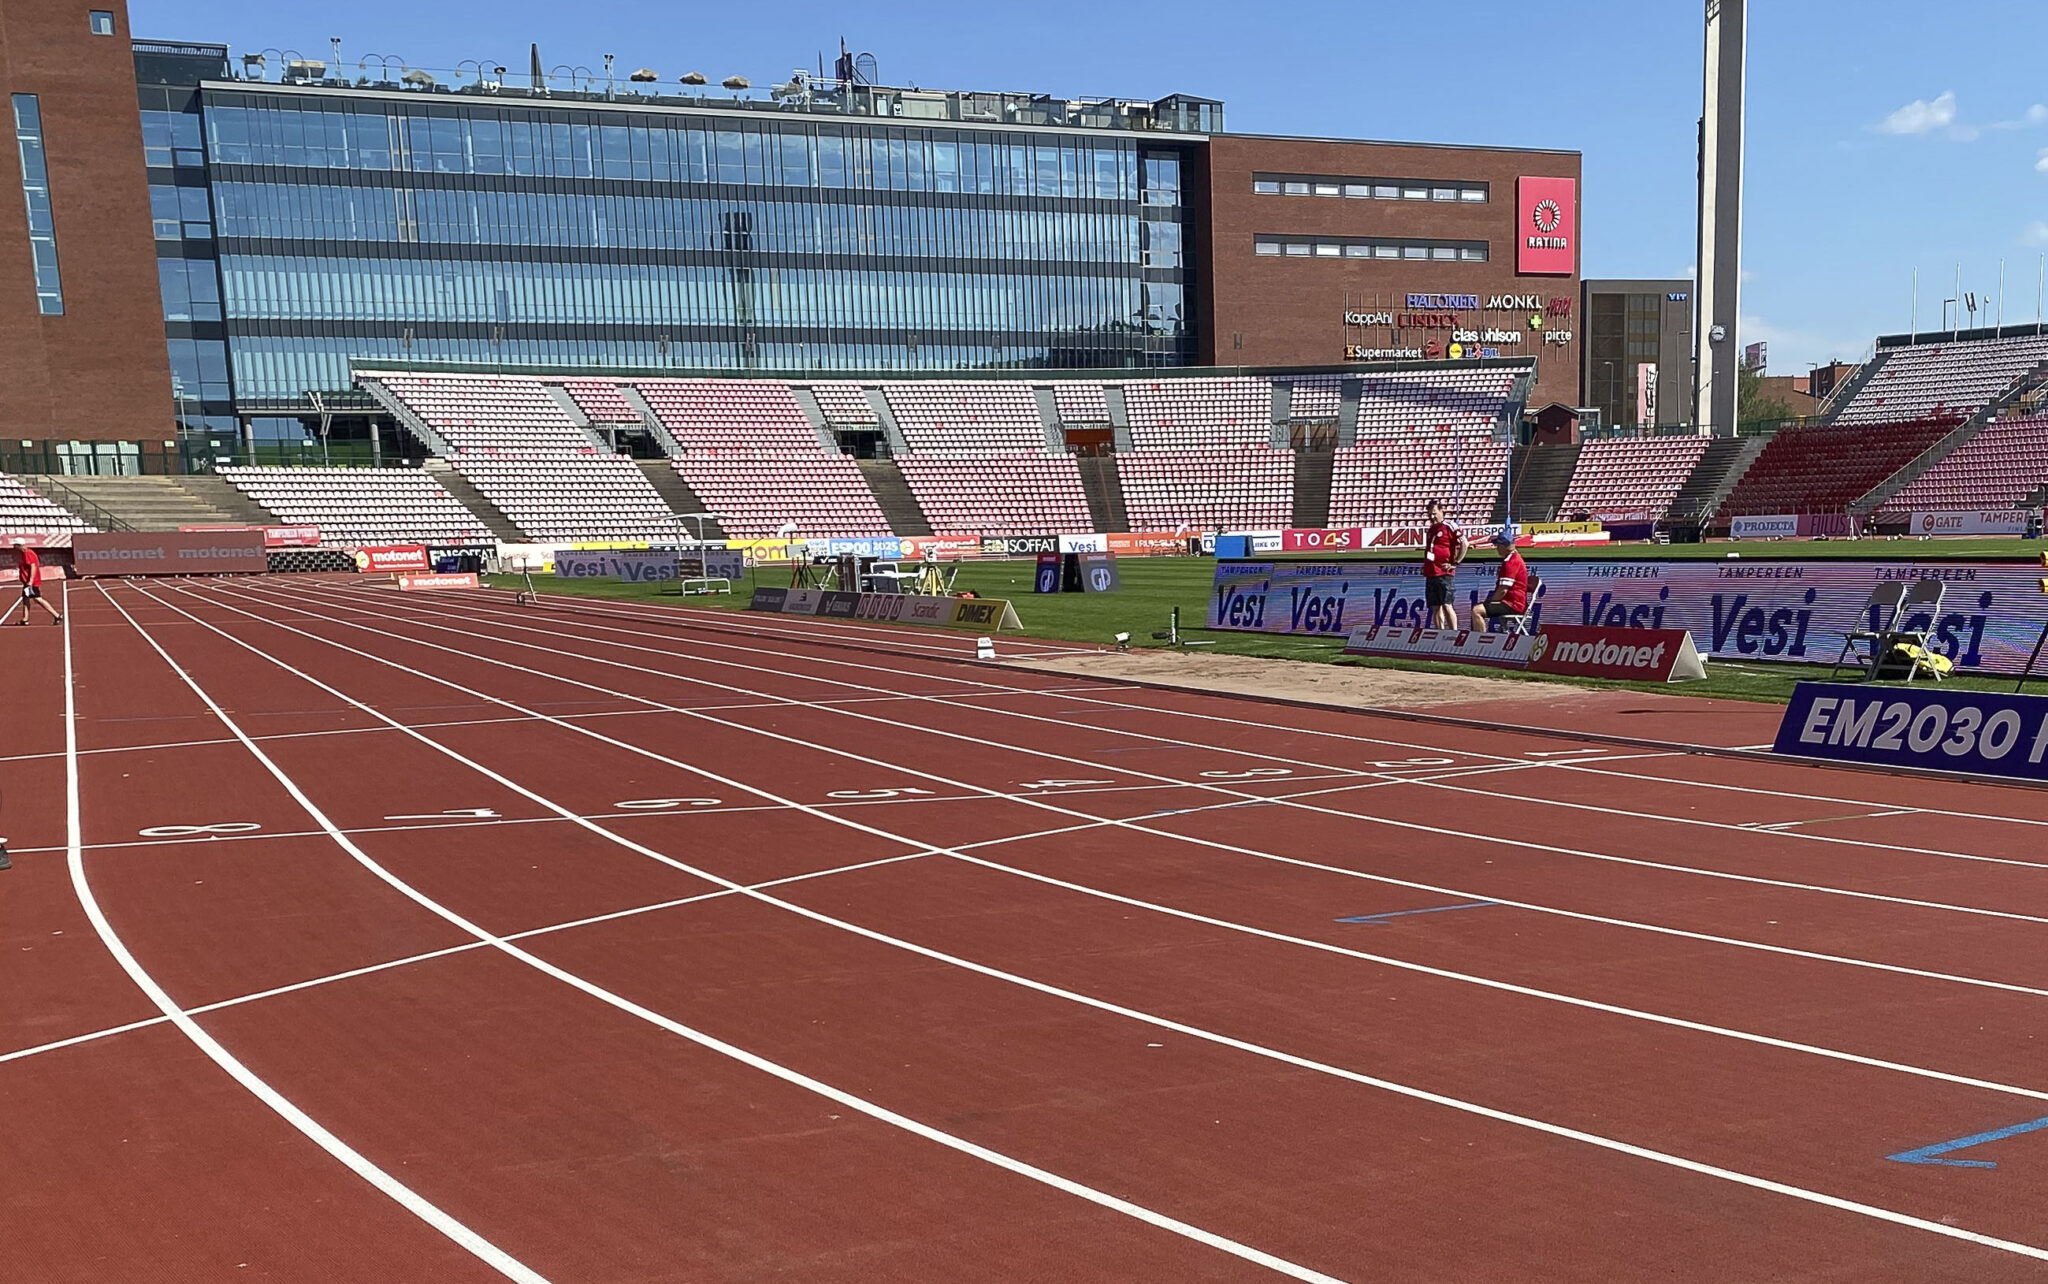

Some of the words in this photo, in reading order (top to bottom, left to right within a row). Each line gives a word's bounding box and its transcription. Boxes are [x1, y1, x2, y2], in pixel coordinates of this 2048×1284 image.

[1528, 236, 1568, 249] RATINA
[1406, 293, 1479, 309] HALONEN
[1668, 293, 1688, 301] YIT
[1398, 313, 1459, 328] LINDEX
[1452, 327, 1479, 342] clas
[1481, 327, 1521, 343] ohlson
[1355, 345, 1422, 359] Supermarket
[1743, 521, 1795, 532] PROJECTA
[1936, 517, 1962, 528] GATE
[77, 546, 166, 560] motonet
[178, 545, 265, 559] motonet
[831, 541, 872, 554] ESPOO
[873, 541, 899, 551] 2025
[1069, 541, 1097, 552] Vesi
[372, 550, 423, 562] motonet
[556, 557, 607, 577] Vesi
[622, 558, 679, 582] Vesi
[706, 558, 742, 580] esi
[1586, 565, 1660, 578] TAMPEREEN
[1718, 566, 1804, 579] TAMPEREEN
[1874, 567, 1977, 582] TAMPEREEN
[413, 576, 472, 587] motonet
[911, 602, 941, 619] Scandic
[1216, 579, 1269, 627] Vesi
[1290, 581, 1349, 633] Vesi
[1581, 585, 1669, 630] Vesi
[956, 603, 997, 624] DIMEX
[1710, 587, 1816, 657] Vesi
[1505, 637, 1514, 650] 8
[1552, 637, 1665, 669] motonet
[1799, 697, 2022, 760] EM2030
